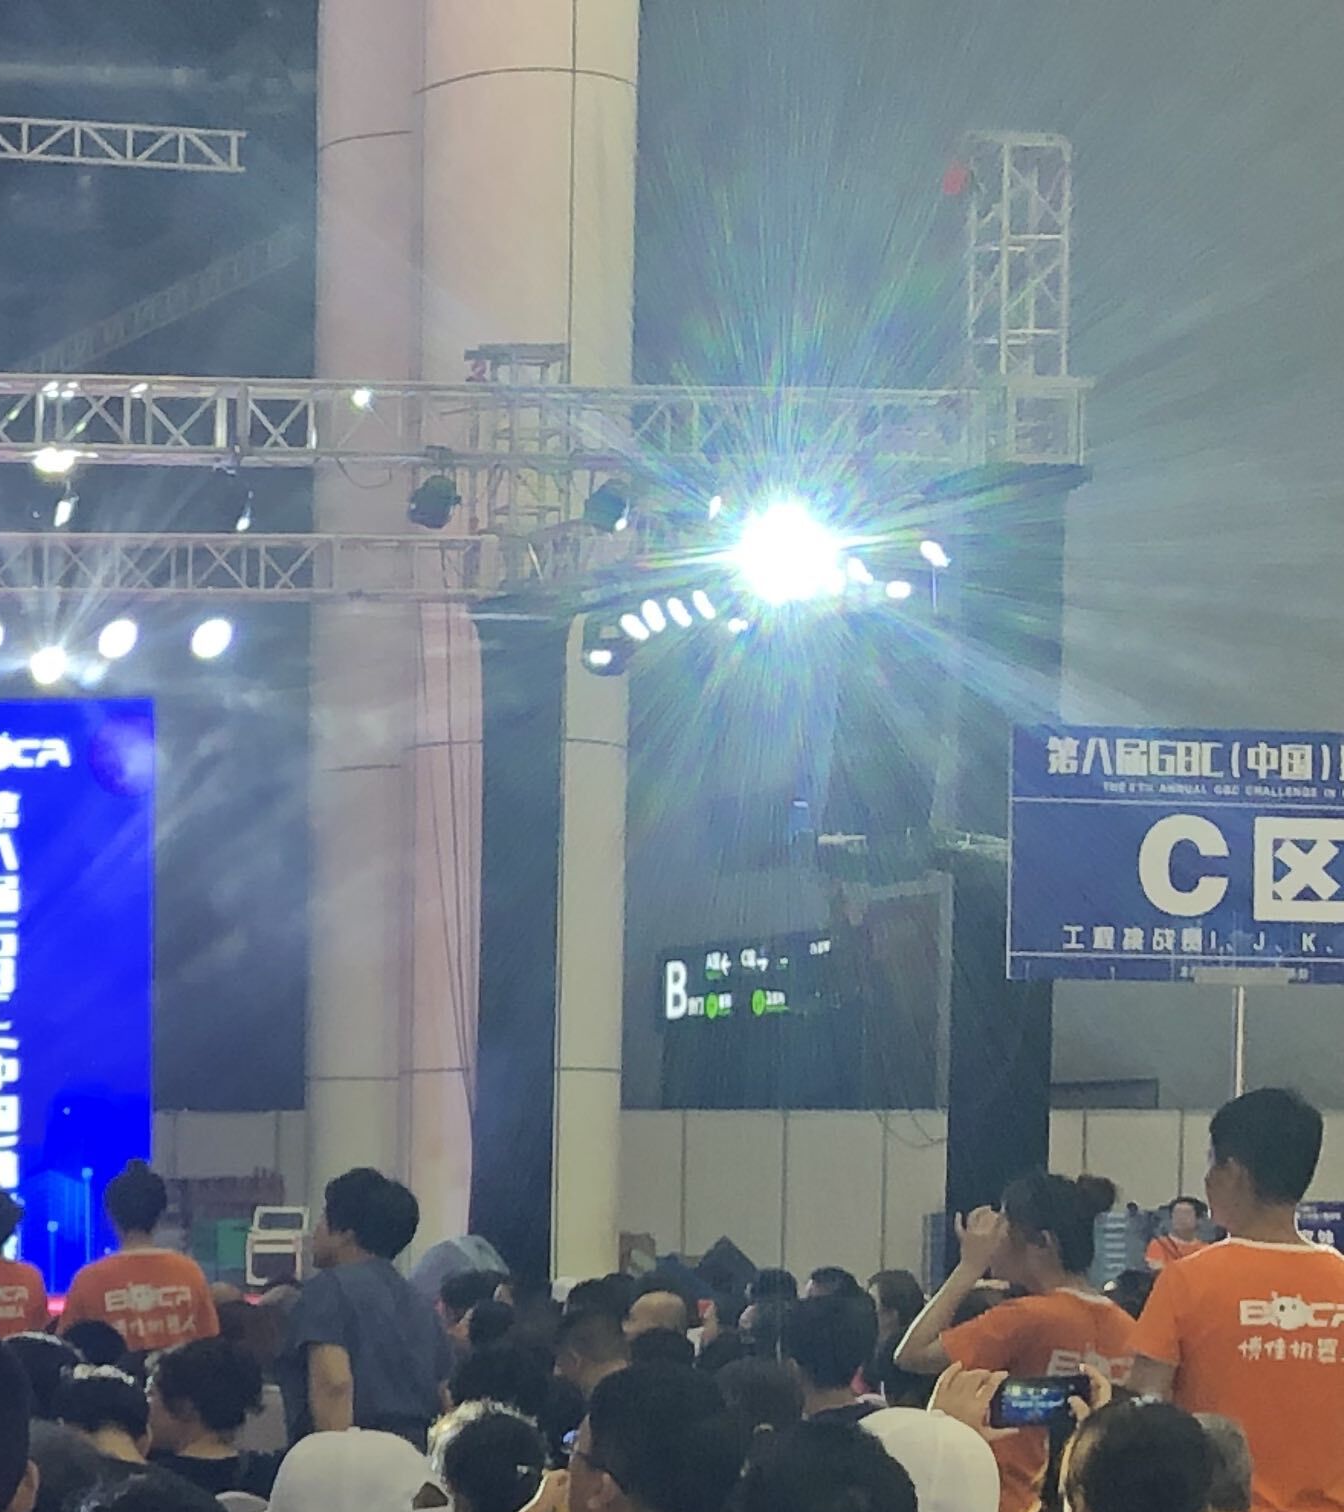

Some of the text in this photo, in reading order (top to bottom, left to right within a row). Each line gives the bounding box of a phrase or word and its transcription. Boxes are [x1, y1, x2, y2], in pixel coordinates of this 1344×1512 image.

[1047, 736, 1344, 781] 第八届GBC（中国）
[1238, 1335, 1344, 1364] 博佳机器
